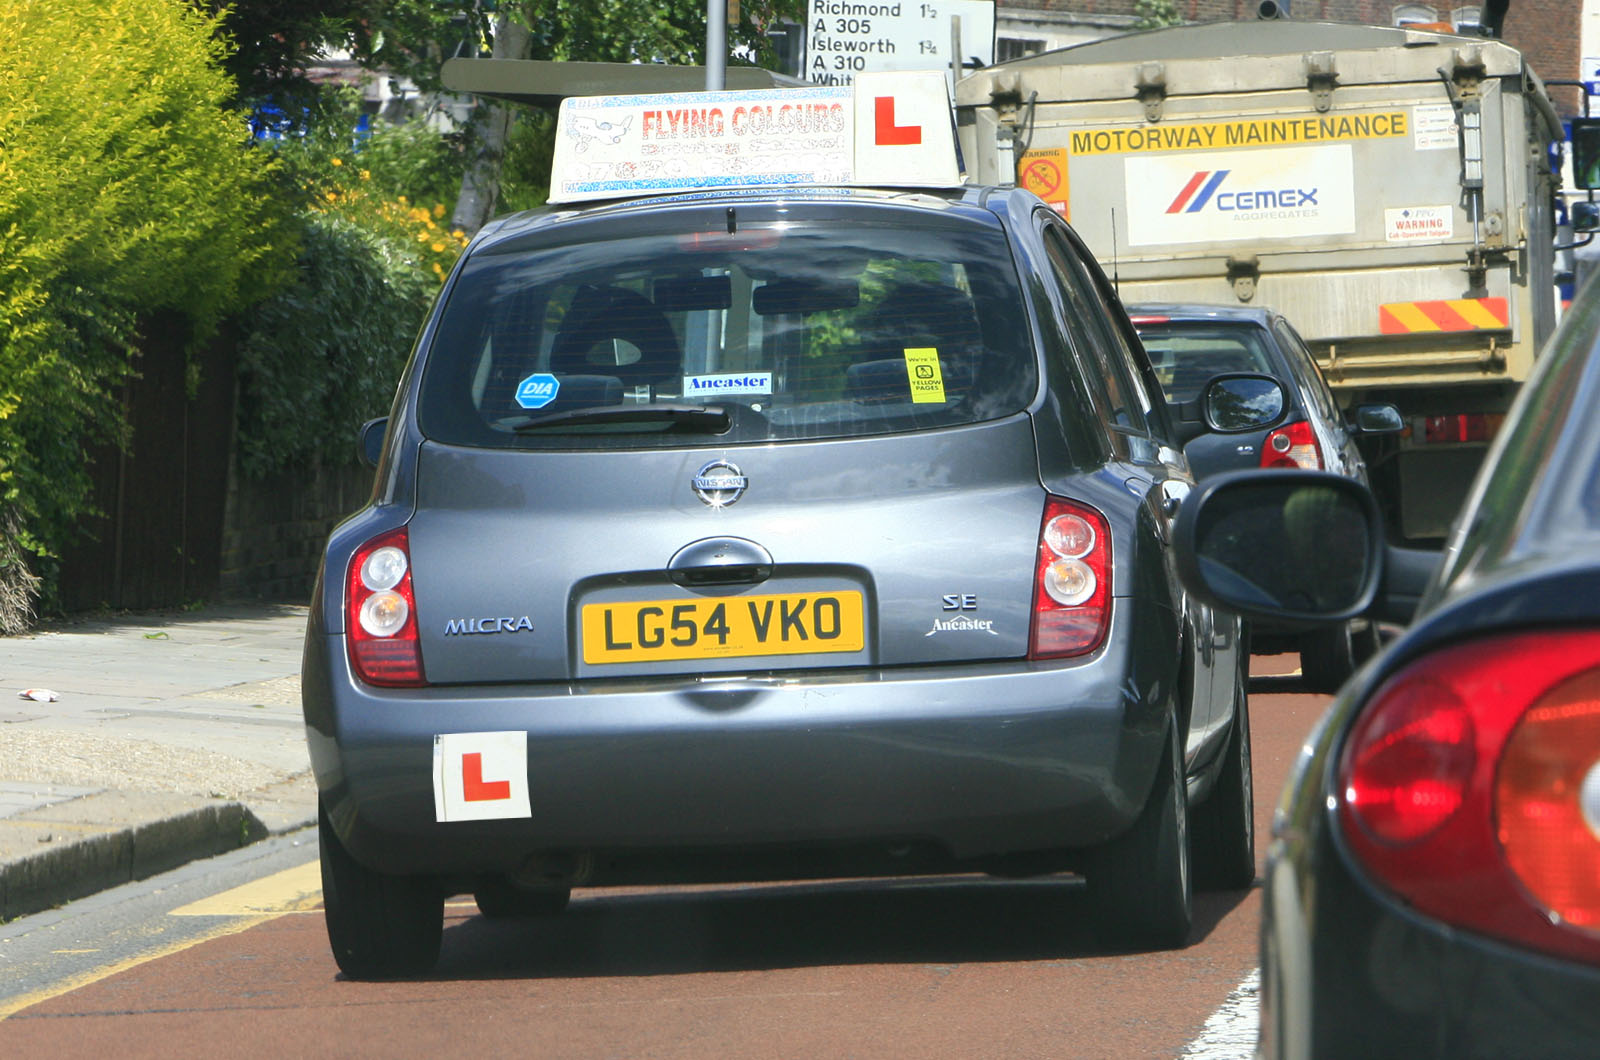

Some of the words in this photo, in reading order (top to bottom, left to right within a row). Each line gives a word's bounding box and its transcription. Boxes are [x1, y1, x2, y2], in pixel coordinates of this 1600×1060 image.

[814, 0, 900, 17] Richmond
[814, 18, 826, 33] A
[836, 19, 871, 34] 305
[812, 37, 895, 53] Isleworth
[813, 55, 826, 70] A
[834, 56, 865, 71] 310
[812, 72, 853, 86] Whit
[642, 107, 724, 140] FLYING
[732, 103, 845, 136] COLOURS
[874, 96, 922, 145] L
[1072, 126, 1217, 153] MOTORWAY
[1225, 114, 1405, 145] MAINTENANCE
[1217, 188, 1318, 211] CEMEX
[1395, 218, 1443, 230] WARNING
[522, 382, 554, 395] DIA
[688, 376, 768, 389] Ancaster
[943, 594, 977, 611] SE
[444, 616, 534, 636] MICRA
[604, 602, 731, 651] LG54
[747, 597, 842, 643] VKO
[932, 618, 993, 631] Ancaster
[461, 751, 512, 802] L
